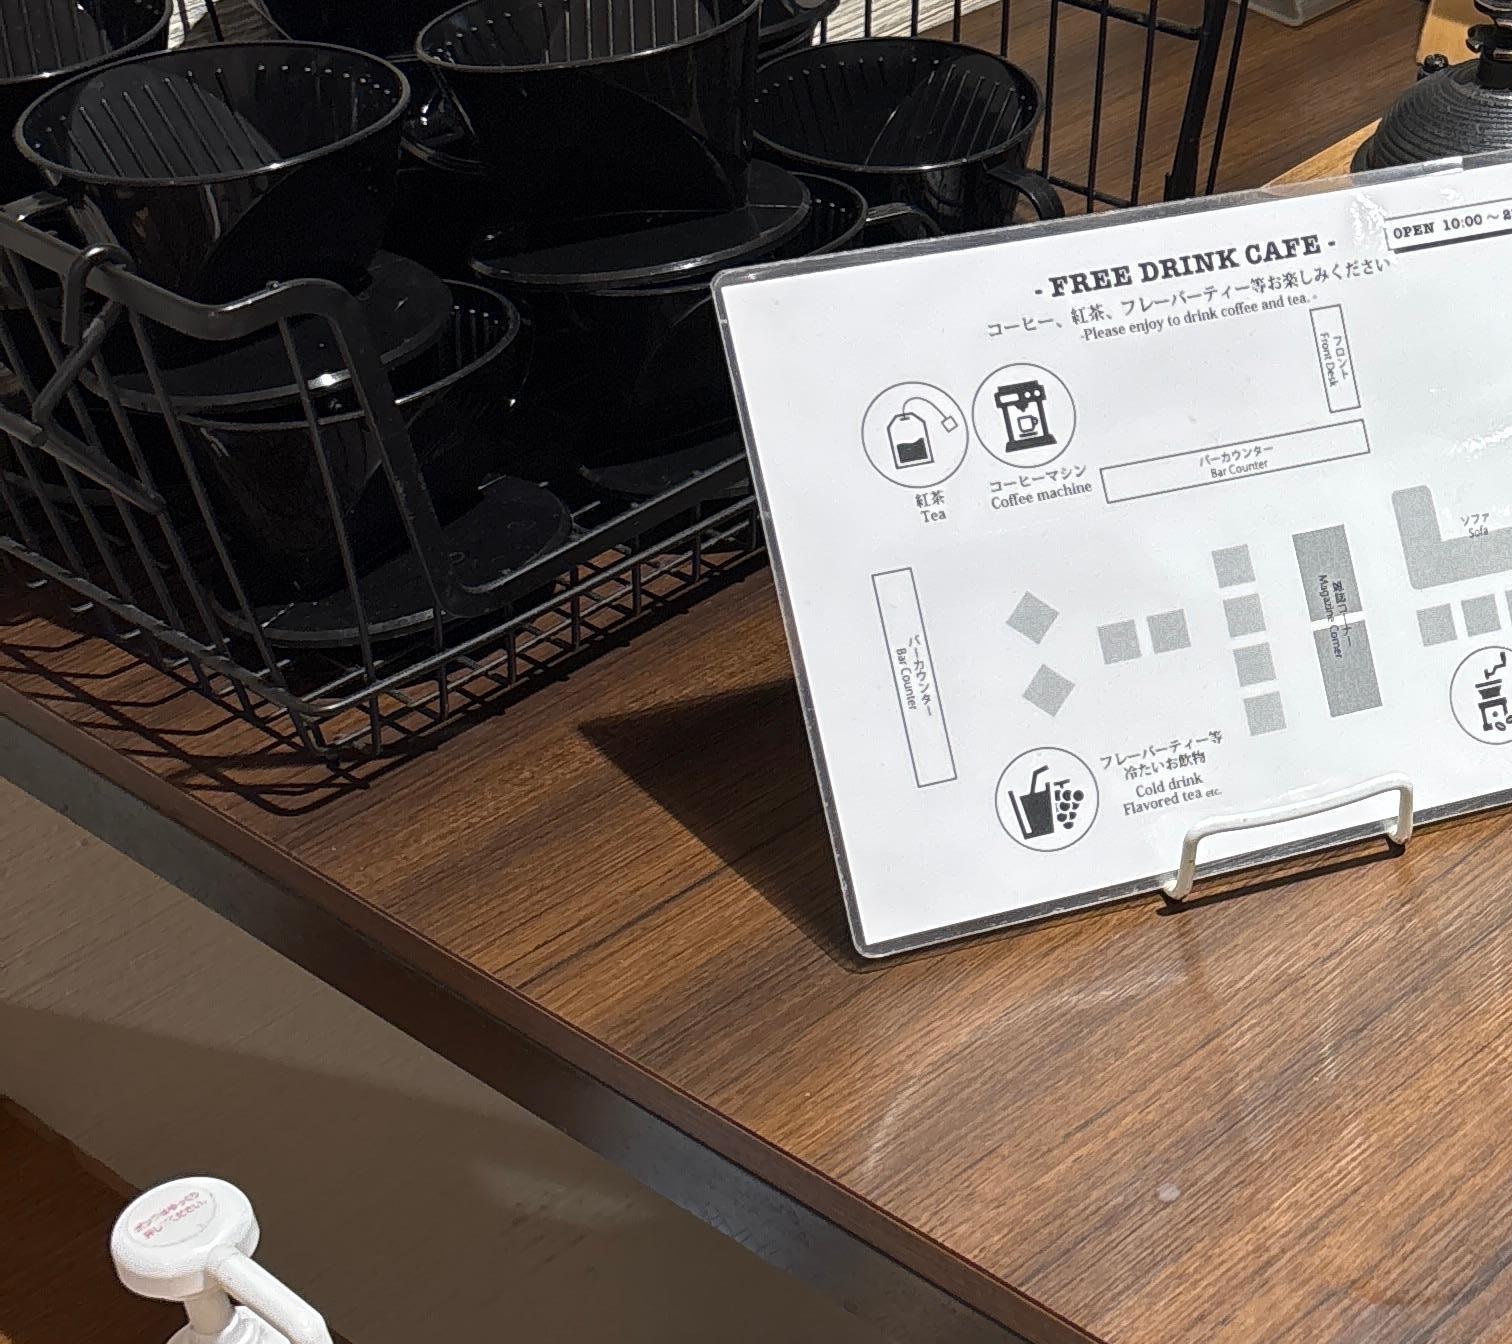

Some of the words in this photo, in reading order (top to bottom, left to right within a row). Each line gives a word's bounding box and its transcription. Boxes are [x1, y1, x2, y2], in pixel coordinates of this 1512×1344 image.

[1393, 222, 1435, 240] OPEN
[1442, 214, 1483, 232] 10:00
[1048, 264, 1134, 298] FREE
[1140, 247, 1241, 285] DRINK
[1245, 234, 1322, 267] CAFE
[987, 257, 1391, 338] コーヒー、紅茶、フレーバーティー等お楽しみください
[1129, 316, 1166, 337] enjoy
[1167, 313, 1181, 327] to
[1183, 304, 1220, 324] drink
[1221, 299, 1259, 319] coffee
[1261, 296, 1285, 312] and
[1319, 332, 1334, 362] Front
[1325, 361, 1339, 388] Desk
[1200, 443, 1275, 467] バーカウンター
[1210, 465, 1229, 479] Bar
[1229, 458, 1269, 476] Counter
[989, 464, 1088, 493] コーヒーマシン
[914, 490, 946, 509] 紅茶
[990, 489, 1036, 511] Coffee
[1037, 480, 1093, 503] machine
[920, 508, 948, 524] Tea
[1460, 512, 1491, 526] ソファ
[1468, 525, 1490, 539] Sofa
[1318, 574, 1335, 622] Magazine
[1329, 624, 1343, 659] Corner
[896, 647, 907, 668] Bar
[908, 633, 933, 717] バーカウンター
[898, 668, 917, 711] Counter
[1100, 729, 1224, 770] フレーバーティー等
[1123, 750, 1207, 781] 冷たいお飲物
[1135, 780, 1166, 798] Cold
[1168, 772, 1204, 792] drink
[1123, 794, 1181, 816] Flavored
[1182, 790, 1204, 803] tea
[1205, 788, 1223, 798] etc.
